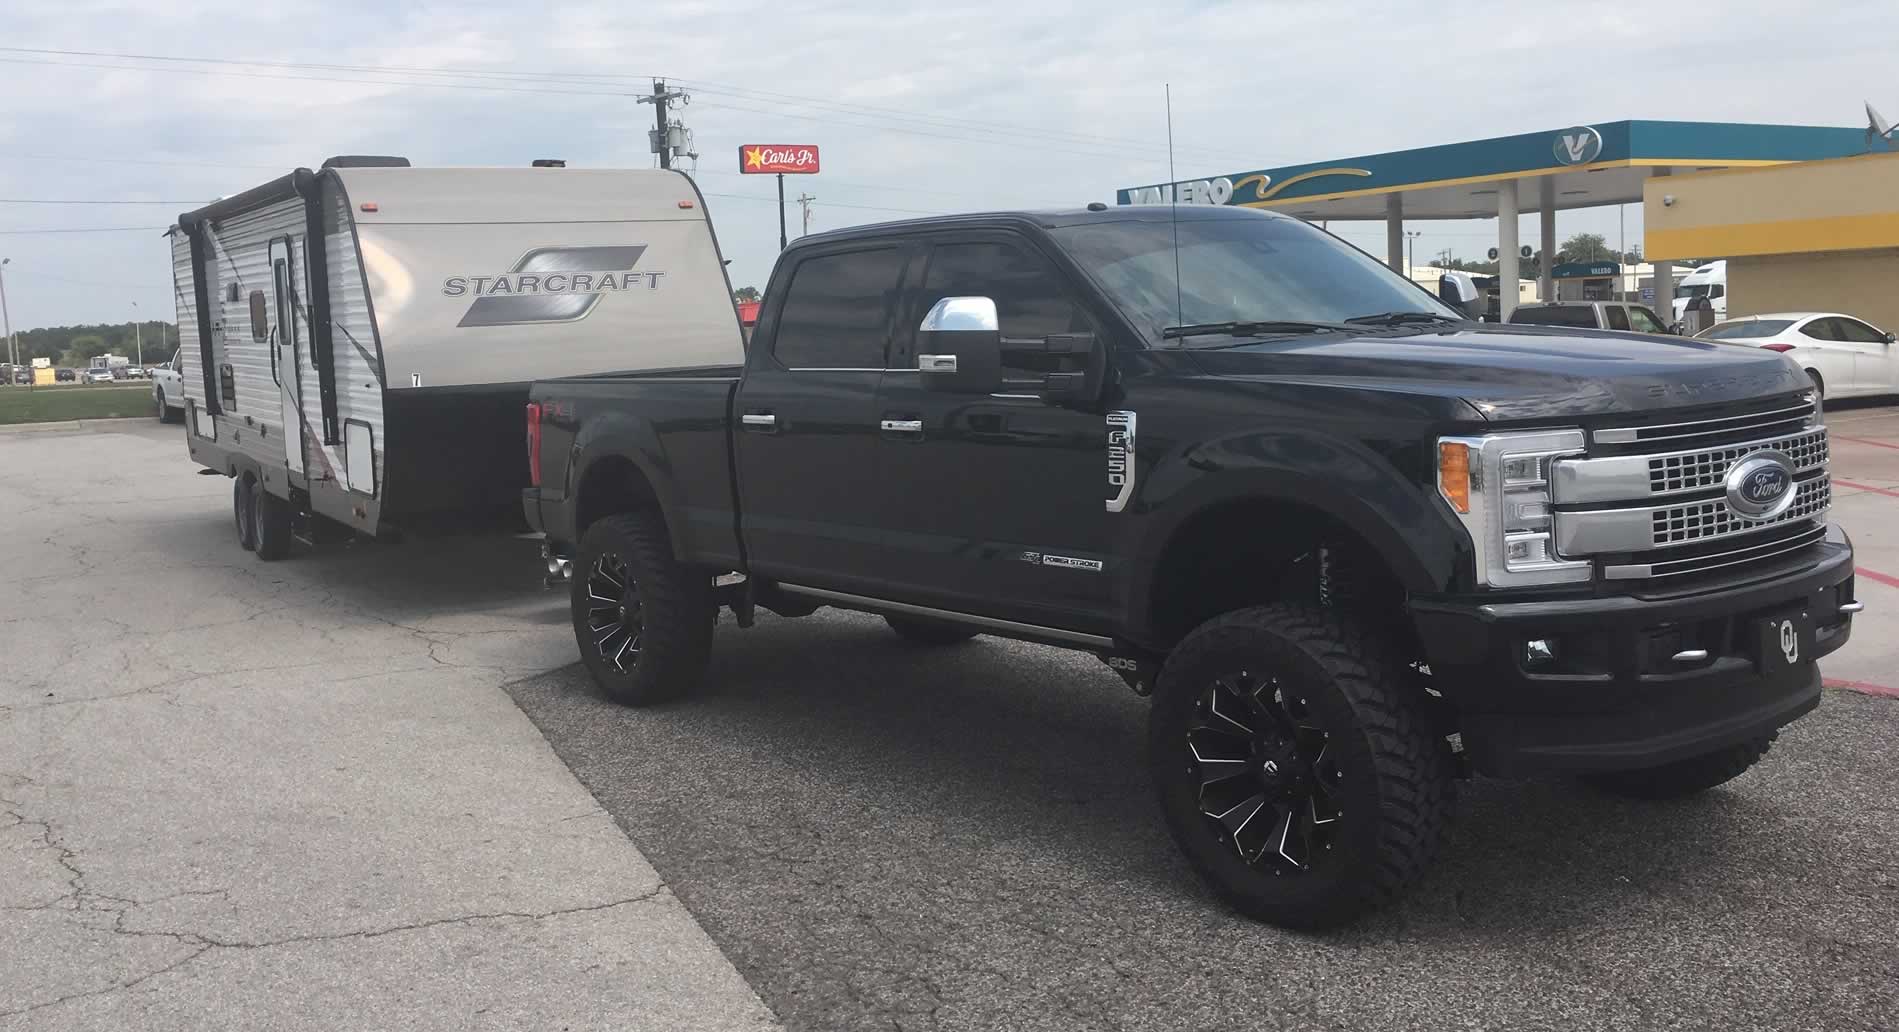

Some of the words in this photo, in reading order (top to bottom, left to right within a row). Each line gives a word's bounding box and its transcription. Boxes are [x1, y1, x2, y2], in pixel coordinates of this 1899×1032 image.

[761, 149, 796, 165] Carl's
[796, 149, 816, 166] Jr.
[1128, 177, 1233, 205] VALERO
[442, 271, 666, 297] STARCRAFT
[412, 373, 420, 387] 7
[1753, 472, 1782, 498] Ford
[1070, 559, 1099, 569] STROKE
